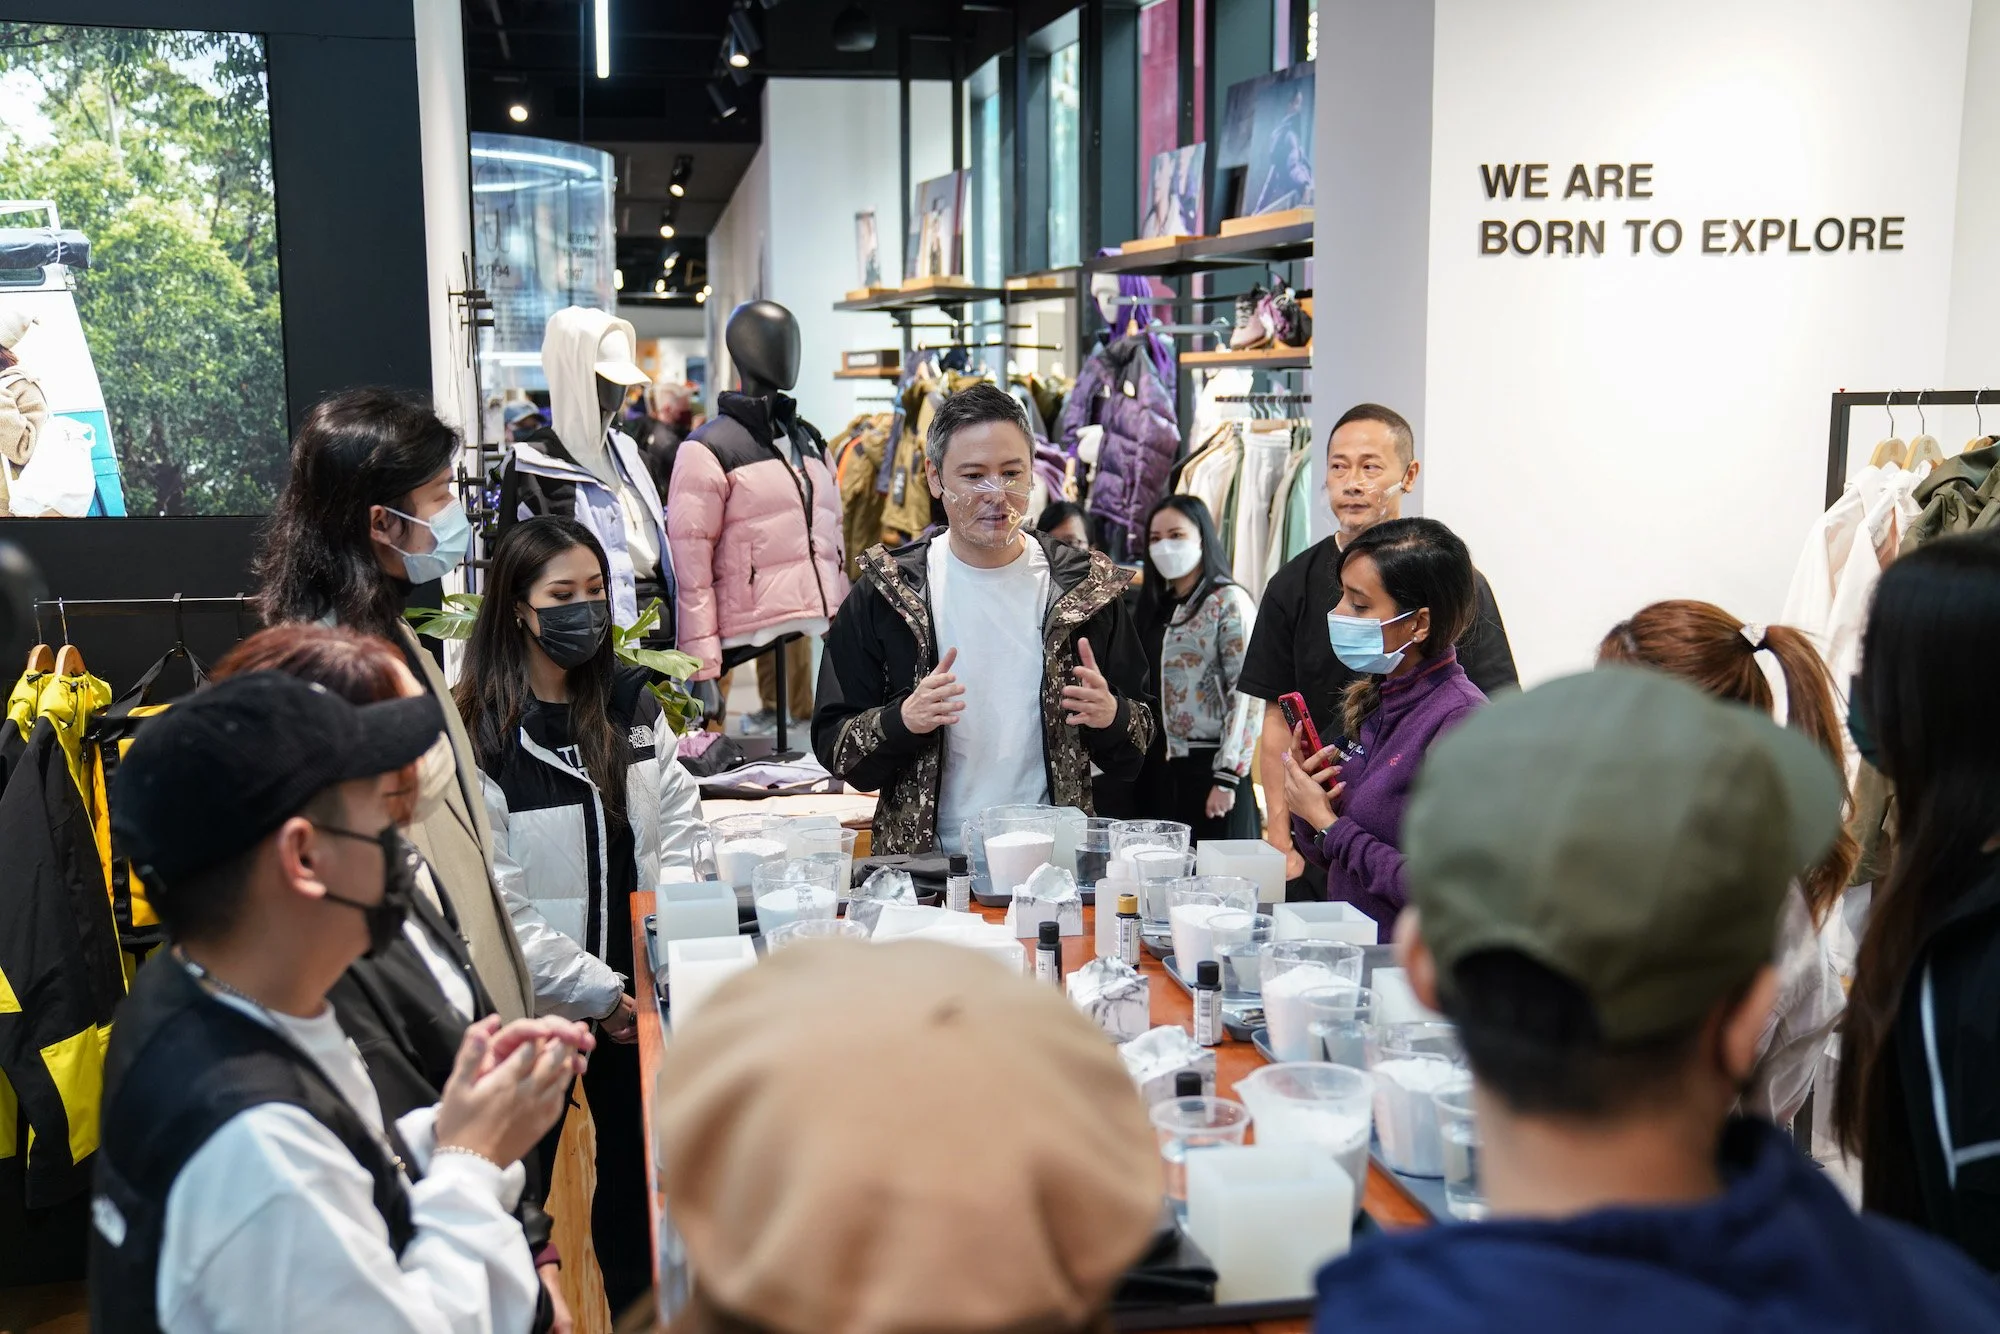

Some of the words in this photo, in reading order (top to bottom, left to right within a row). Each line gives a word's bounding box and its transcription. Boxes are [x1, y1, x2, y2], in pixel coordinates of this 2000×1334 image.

[1480, 163, 1549, 198] WE
[1563, 163, 1653, 198] ARE
[1480, 219, 1605, 254] BORN
[1624, 218, 1683, 254] TO
[1702, 216, 1905, 253] EXPLORE
